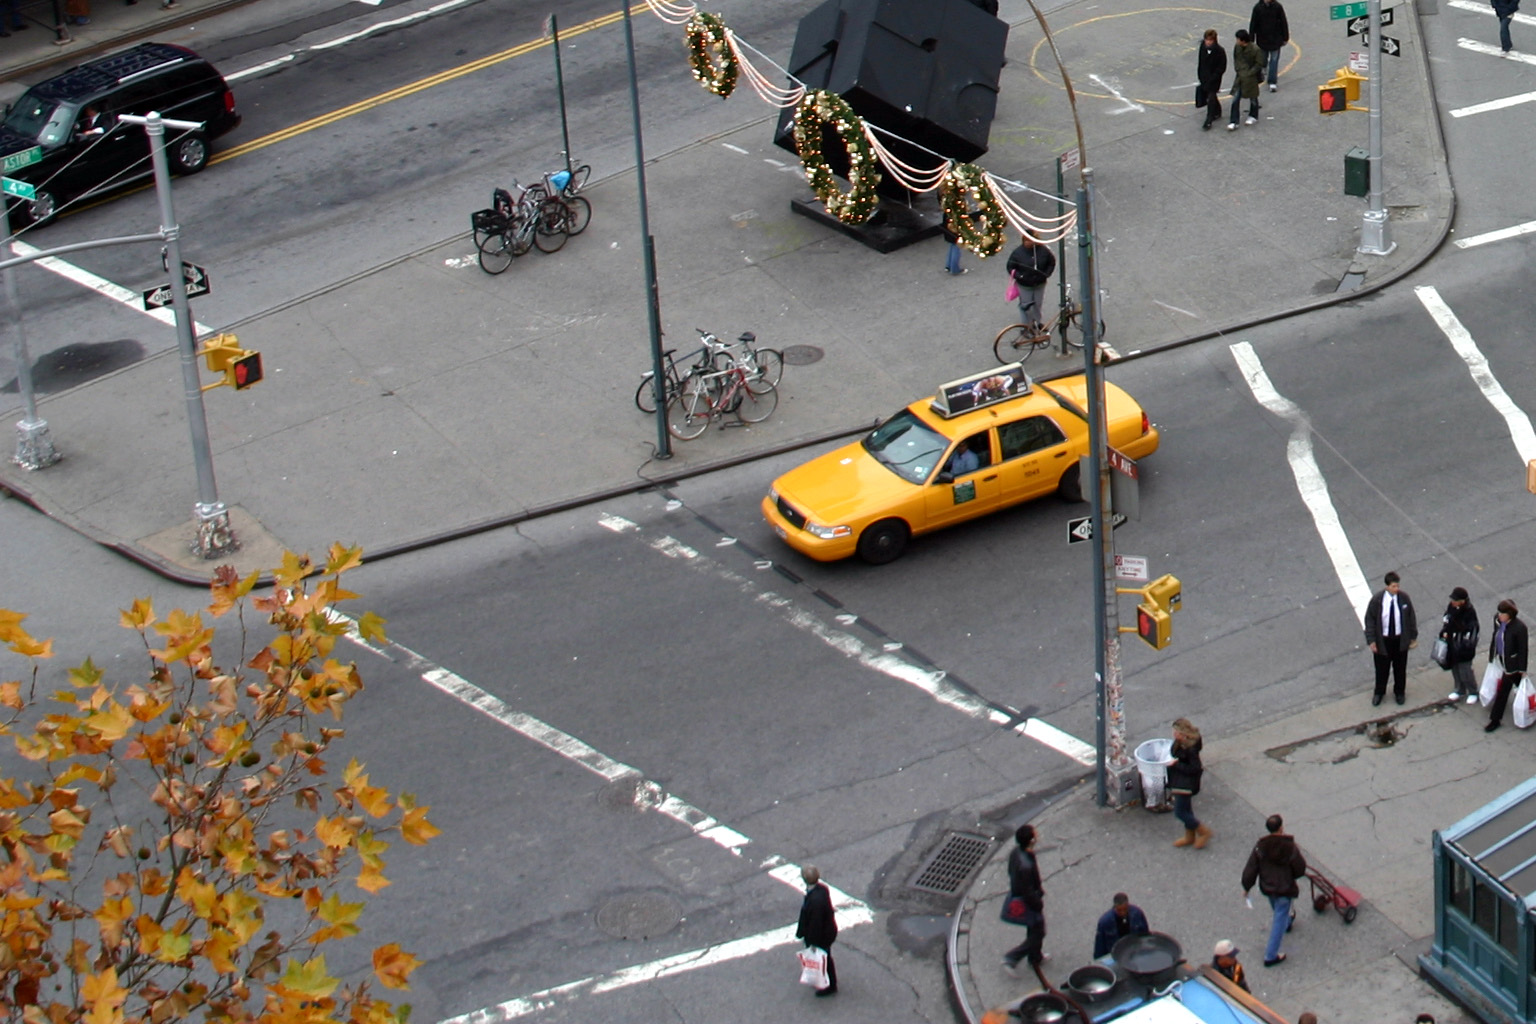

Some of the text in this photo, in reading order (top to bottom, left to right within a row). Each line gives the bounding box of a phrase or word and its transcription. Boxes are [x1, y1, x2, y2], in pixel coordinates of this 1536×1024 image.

[1345, 5, 1352, 16] 8
[4, 151, 30, 170] ASTOR
[9, 182, 17, 194] 4
[154, 290, 172, 302] ONE
[1111, 452, 1133, 477] 4 AVE
